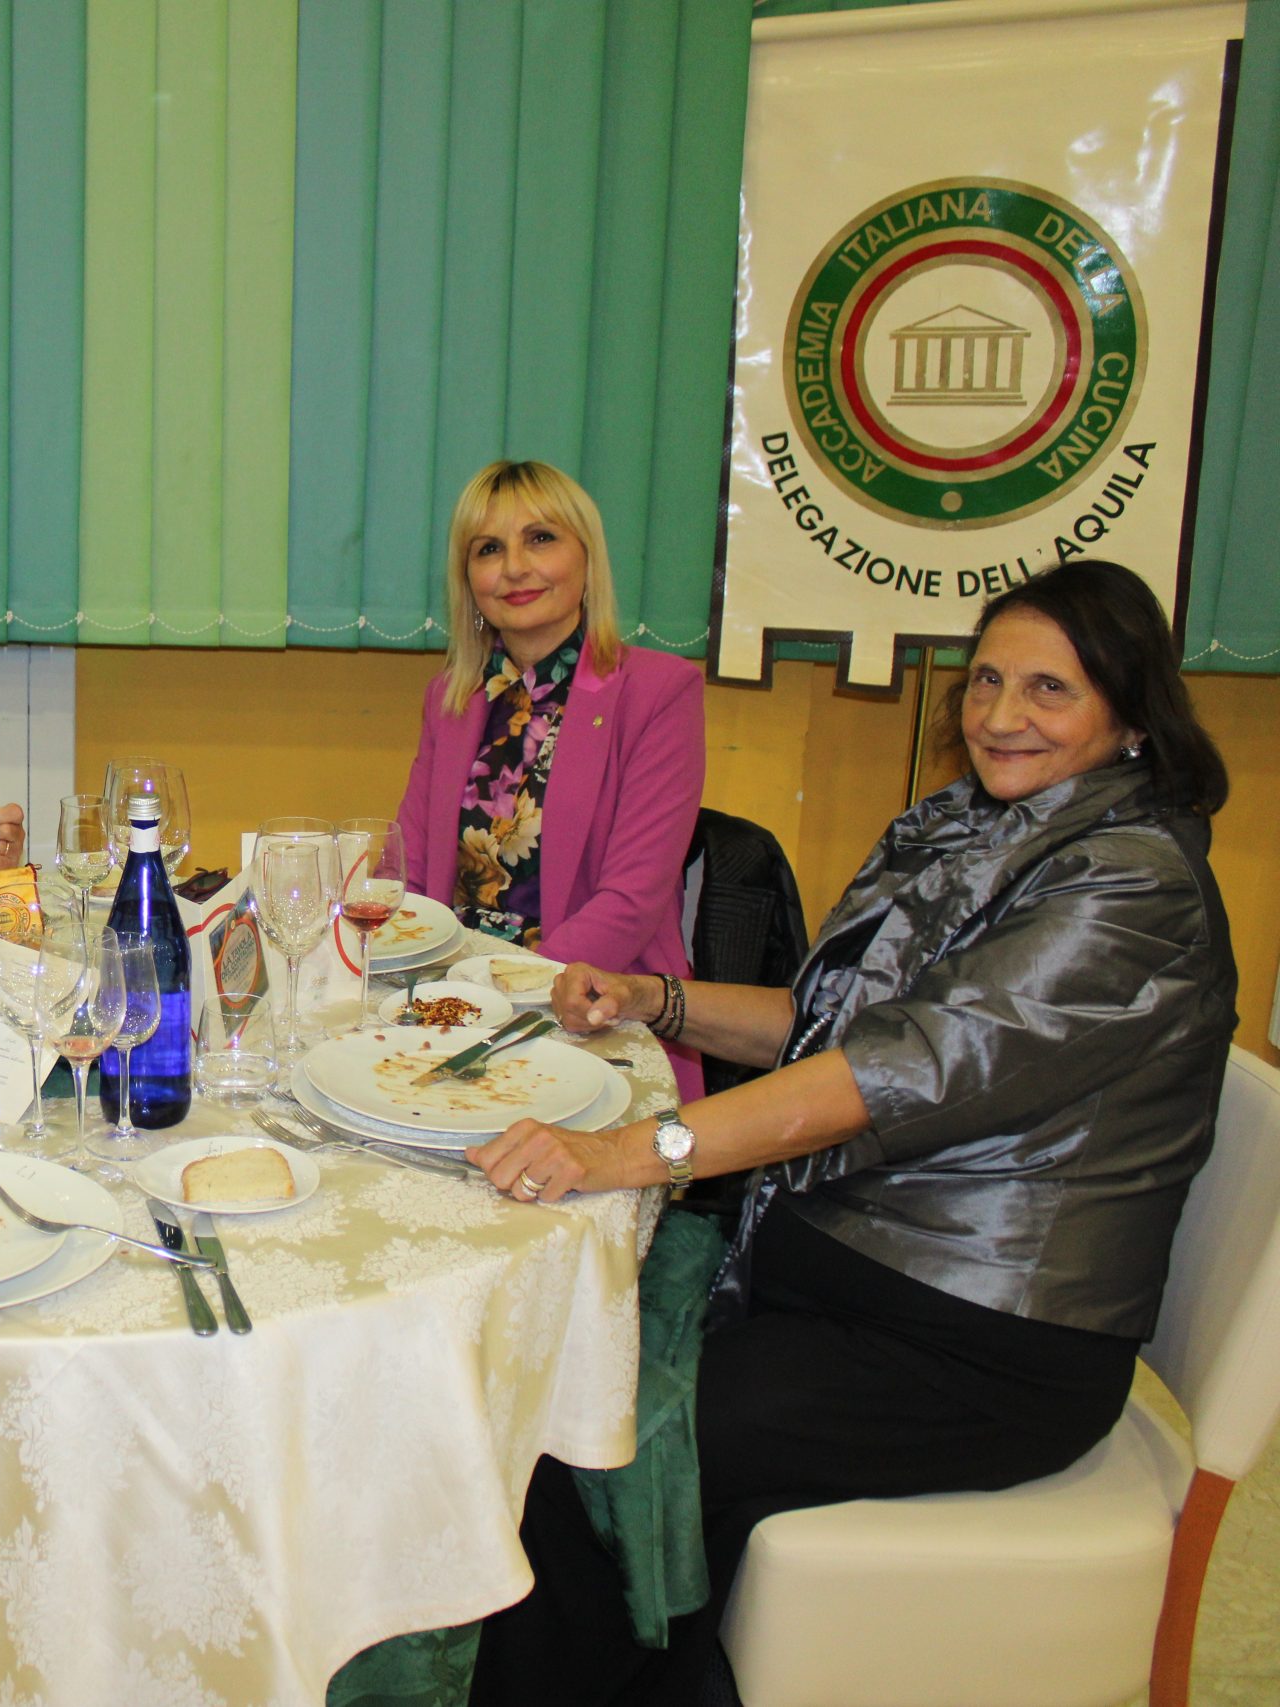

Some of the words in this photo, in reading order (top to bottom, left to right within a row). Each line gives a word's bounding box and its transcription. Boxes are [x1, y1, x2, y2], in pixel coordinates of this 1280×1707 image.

[838, 192, 993, 273] ITALIANA
[1034, 212, 1128, 319] DELLA
[797, 300, 887, 484] ACCADEMIA
[1035, 351, 1130, 482] CUCINA
[761, 432, 942, 597] DELEGAZIONE
